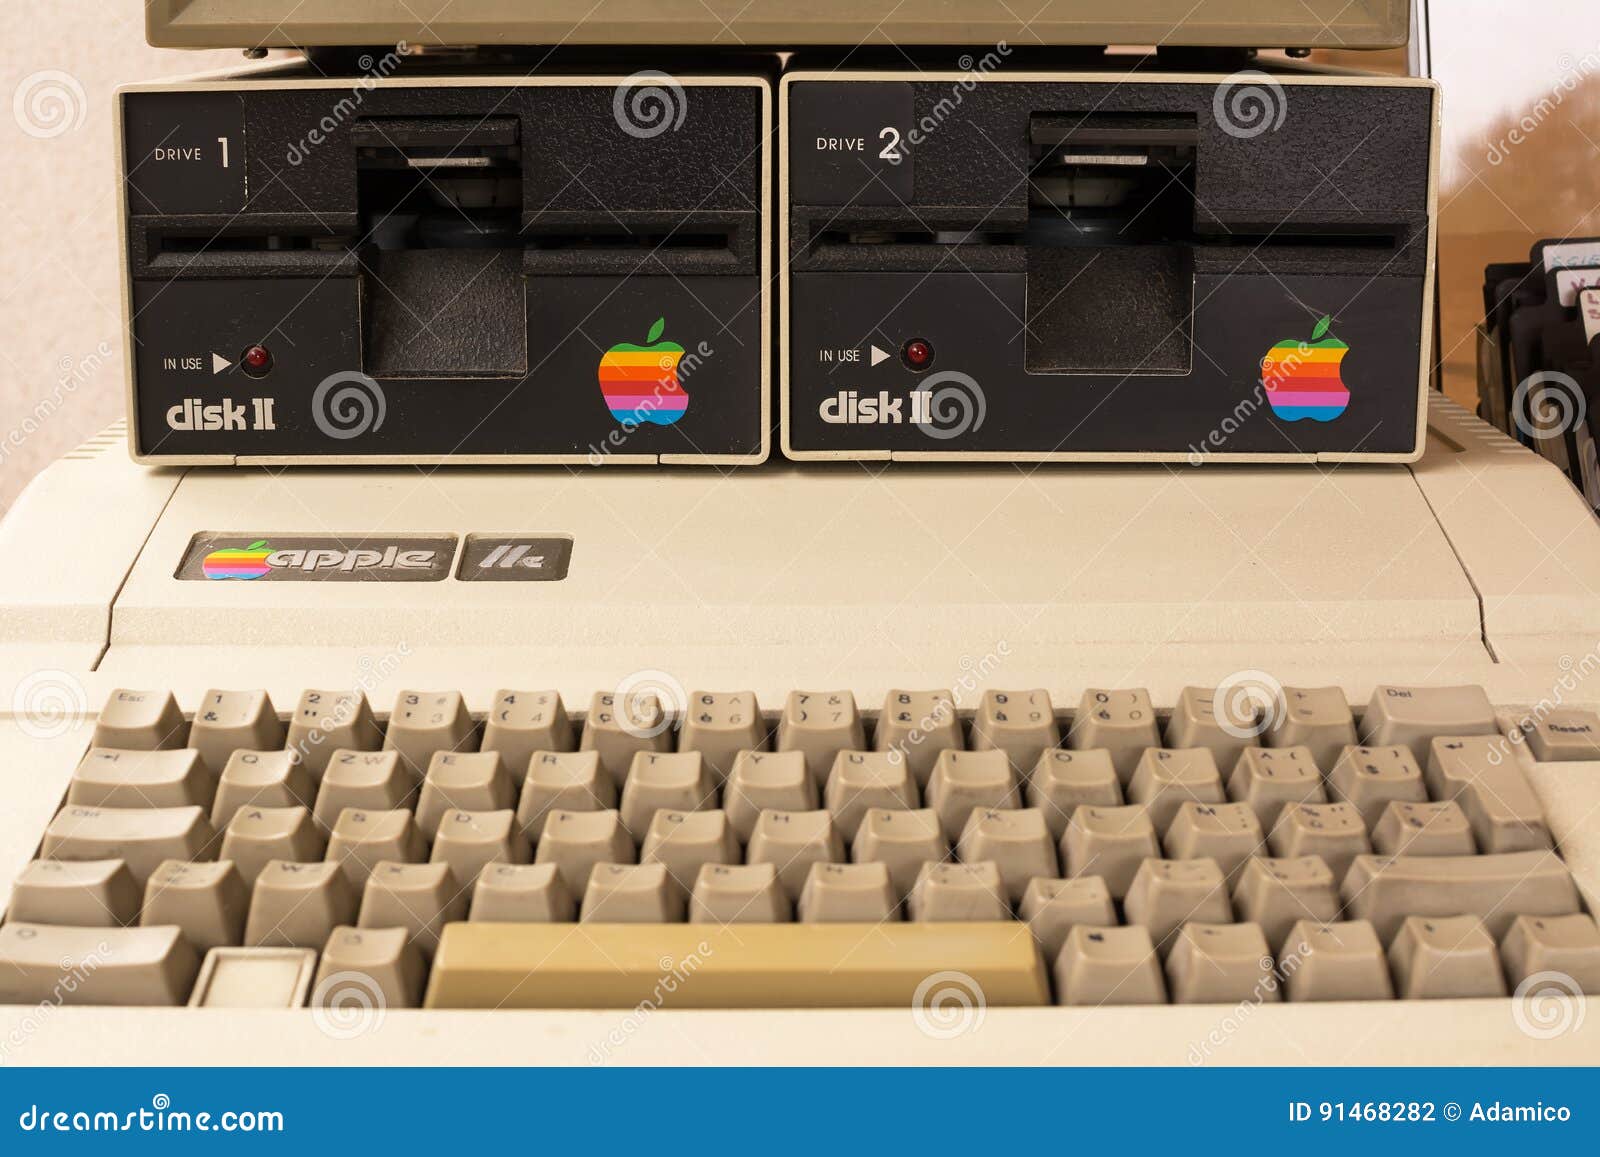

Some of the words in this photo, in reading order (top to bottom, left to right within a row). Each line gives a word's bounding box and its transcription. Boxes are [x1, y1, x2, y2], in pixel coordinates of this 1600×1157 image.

[816, 137, 865, 151] DRIVE
[879, 127, 901, 159] 2
[155, 147, 201, 161] DRIVE
[217, 137, 229, 168] 1
[819, 350, 833, 362] IN
[838, 349, 860, 362] USE
[163, 358, 177, 370] IN
[181, 358, 202, 370] USE
[819, 390, 903, 424] disk
[166, 398, 247, 431] disk
[265, 546, 438, 572] apple
[118, 692, 145, 702] Esc
[308, 693, 321, 704] 2
[1386, 688, 1412, 699] Del
[406, 695, 419, 705] 3
[503, 695, 516, 704] 4
[702, 695, 714, 705] 6
[799, 695, 810, 704] 7
[898, 694, 911, 704] 8
[996, 694, 1008, 704] 9
[1548, 724, 1592, 734] Reset
[542, 755, 557, 764] R
